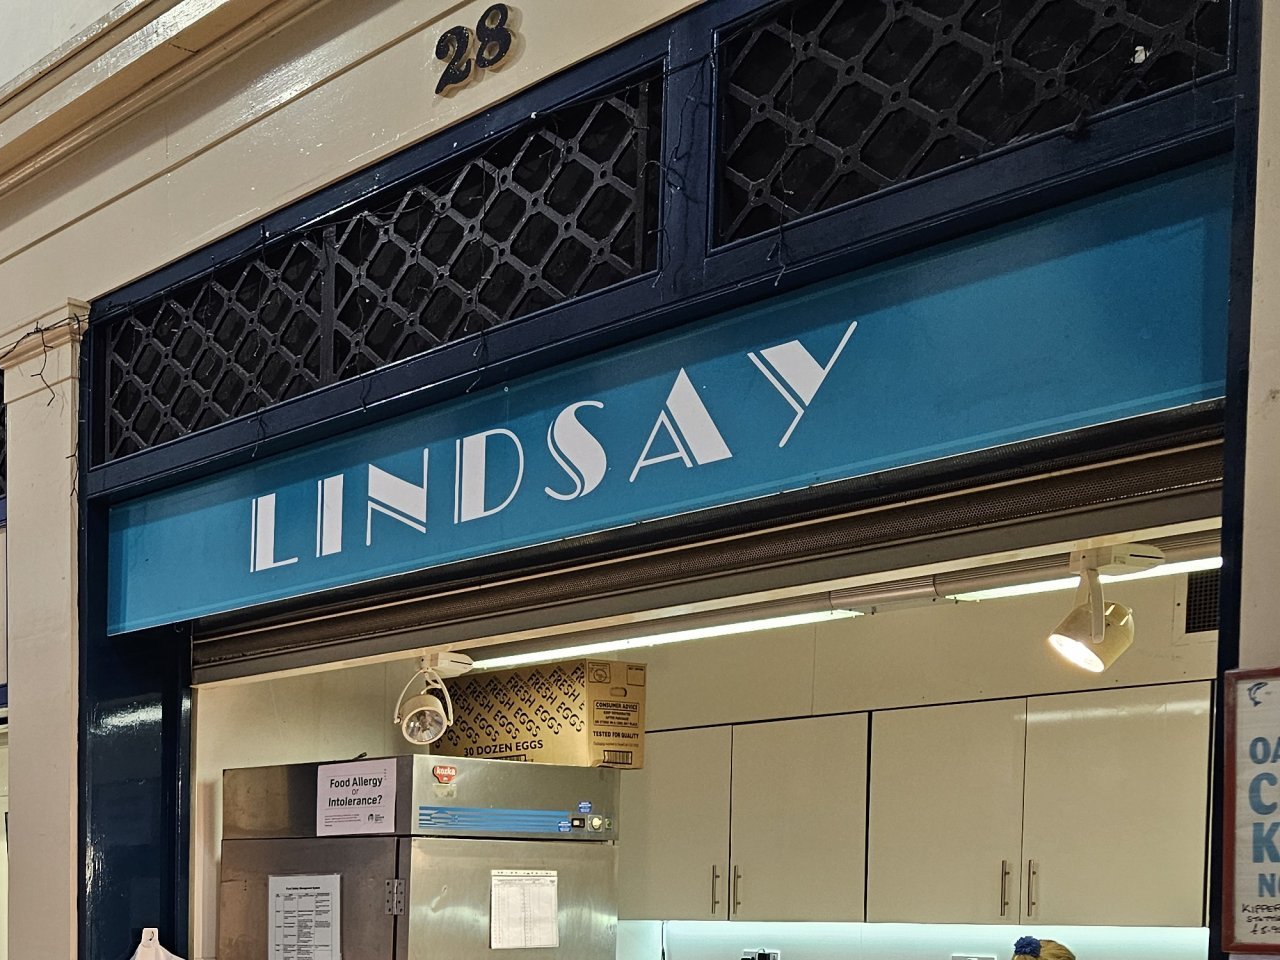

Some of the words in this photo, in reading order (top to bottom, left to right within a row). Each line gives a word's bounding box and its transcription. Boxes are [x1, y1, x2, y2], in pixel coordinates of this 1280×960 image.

[435, 3, 512, 94] 28
[250, 321, 858, 573] LINDSAY
[549, 669, 580, 702] FRESH
[473, 712, 499, 742] EGGS
[493, 710, 520, 739] EGGS
[513, 707, 540, 737] EGGS
[534, 704, 562, 734] EGGS
[556, 701, 585, 732] EGGS
[464, 747, 474, 757] 30
[477, 743, 513, 755] DOZEN
[516, 740, 543, 751] EGGS
[330, 777, 351, 788] Food
[352, 776, 383, 788] Allergy
[328, 794, 383, 807] Intolerance?
